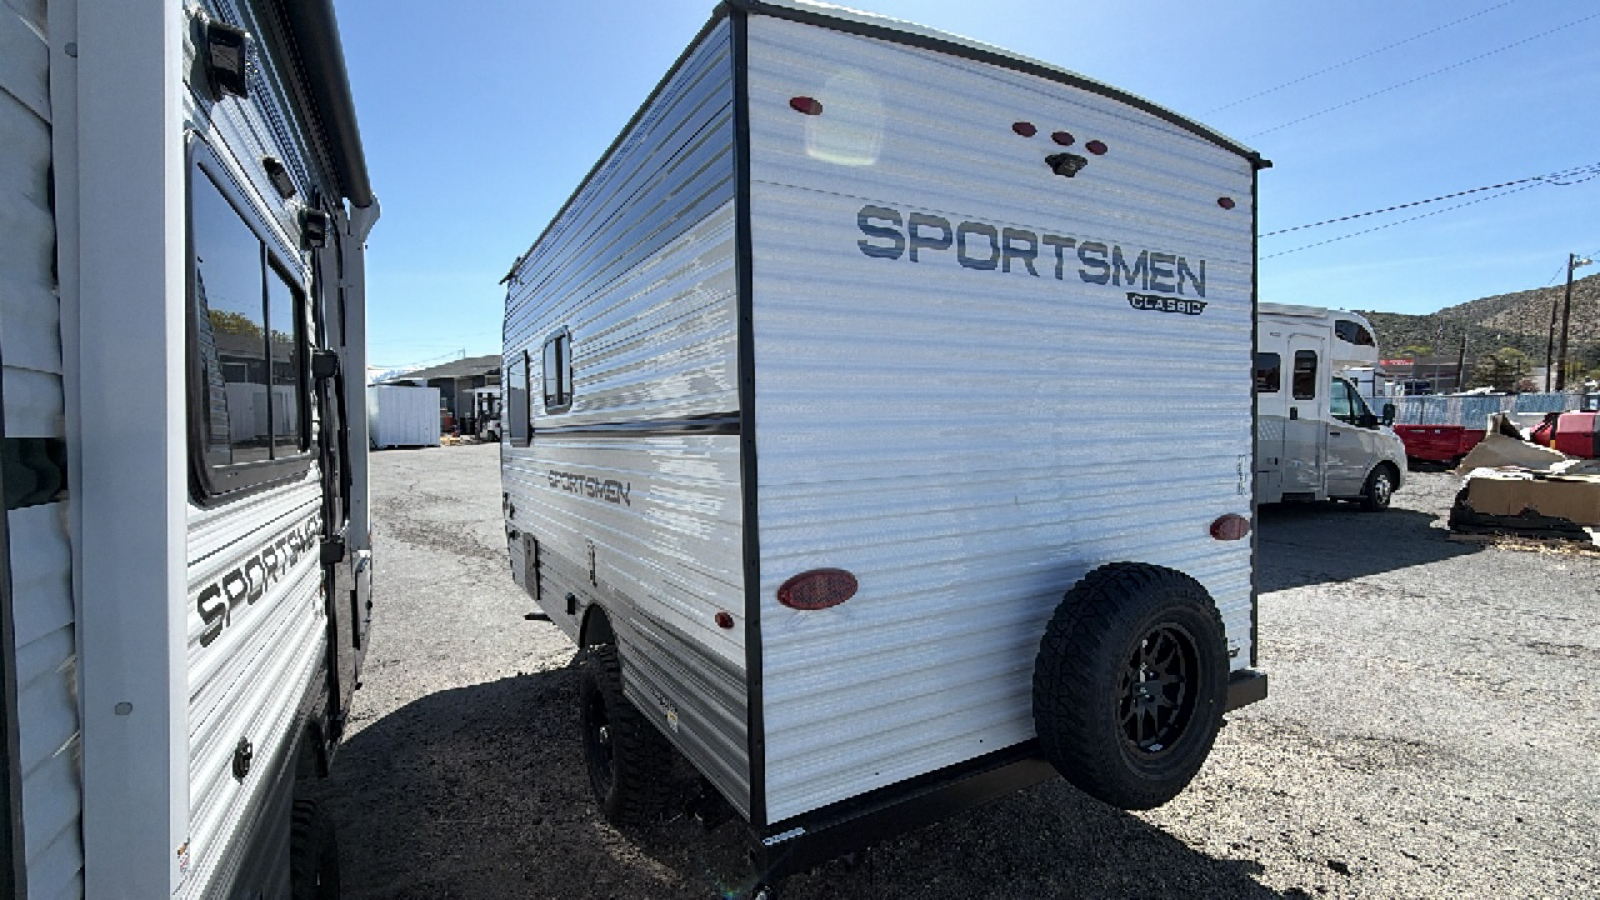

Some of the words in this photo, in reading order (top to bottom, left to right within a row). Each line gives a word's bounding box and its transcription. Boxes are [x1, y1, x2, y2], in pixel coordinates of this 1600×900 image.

[857, 205, 1206, 298] SPORTSMEN
[1131, 294, 1202, 314] CLASSIC
[548, 470, 631, 506] SPORTSMEN
